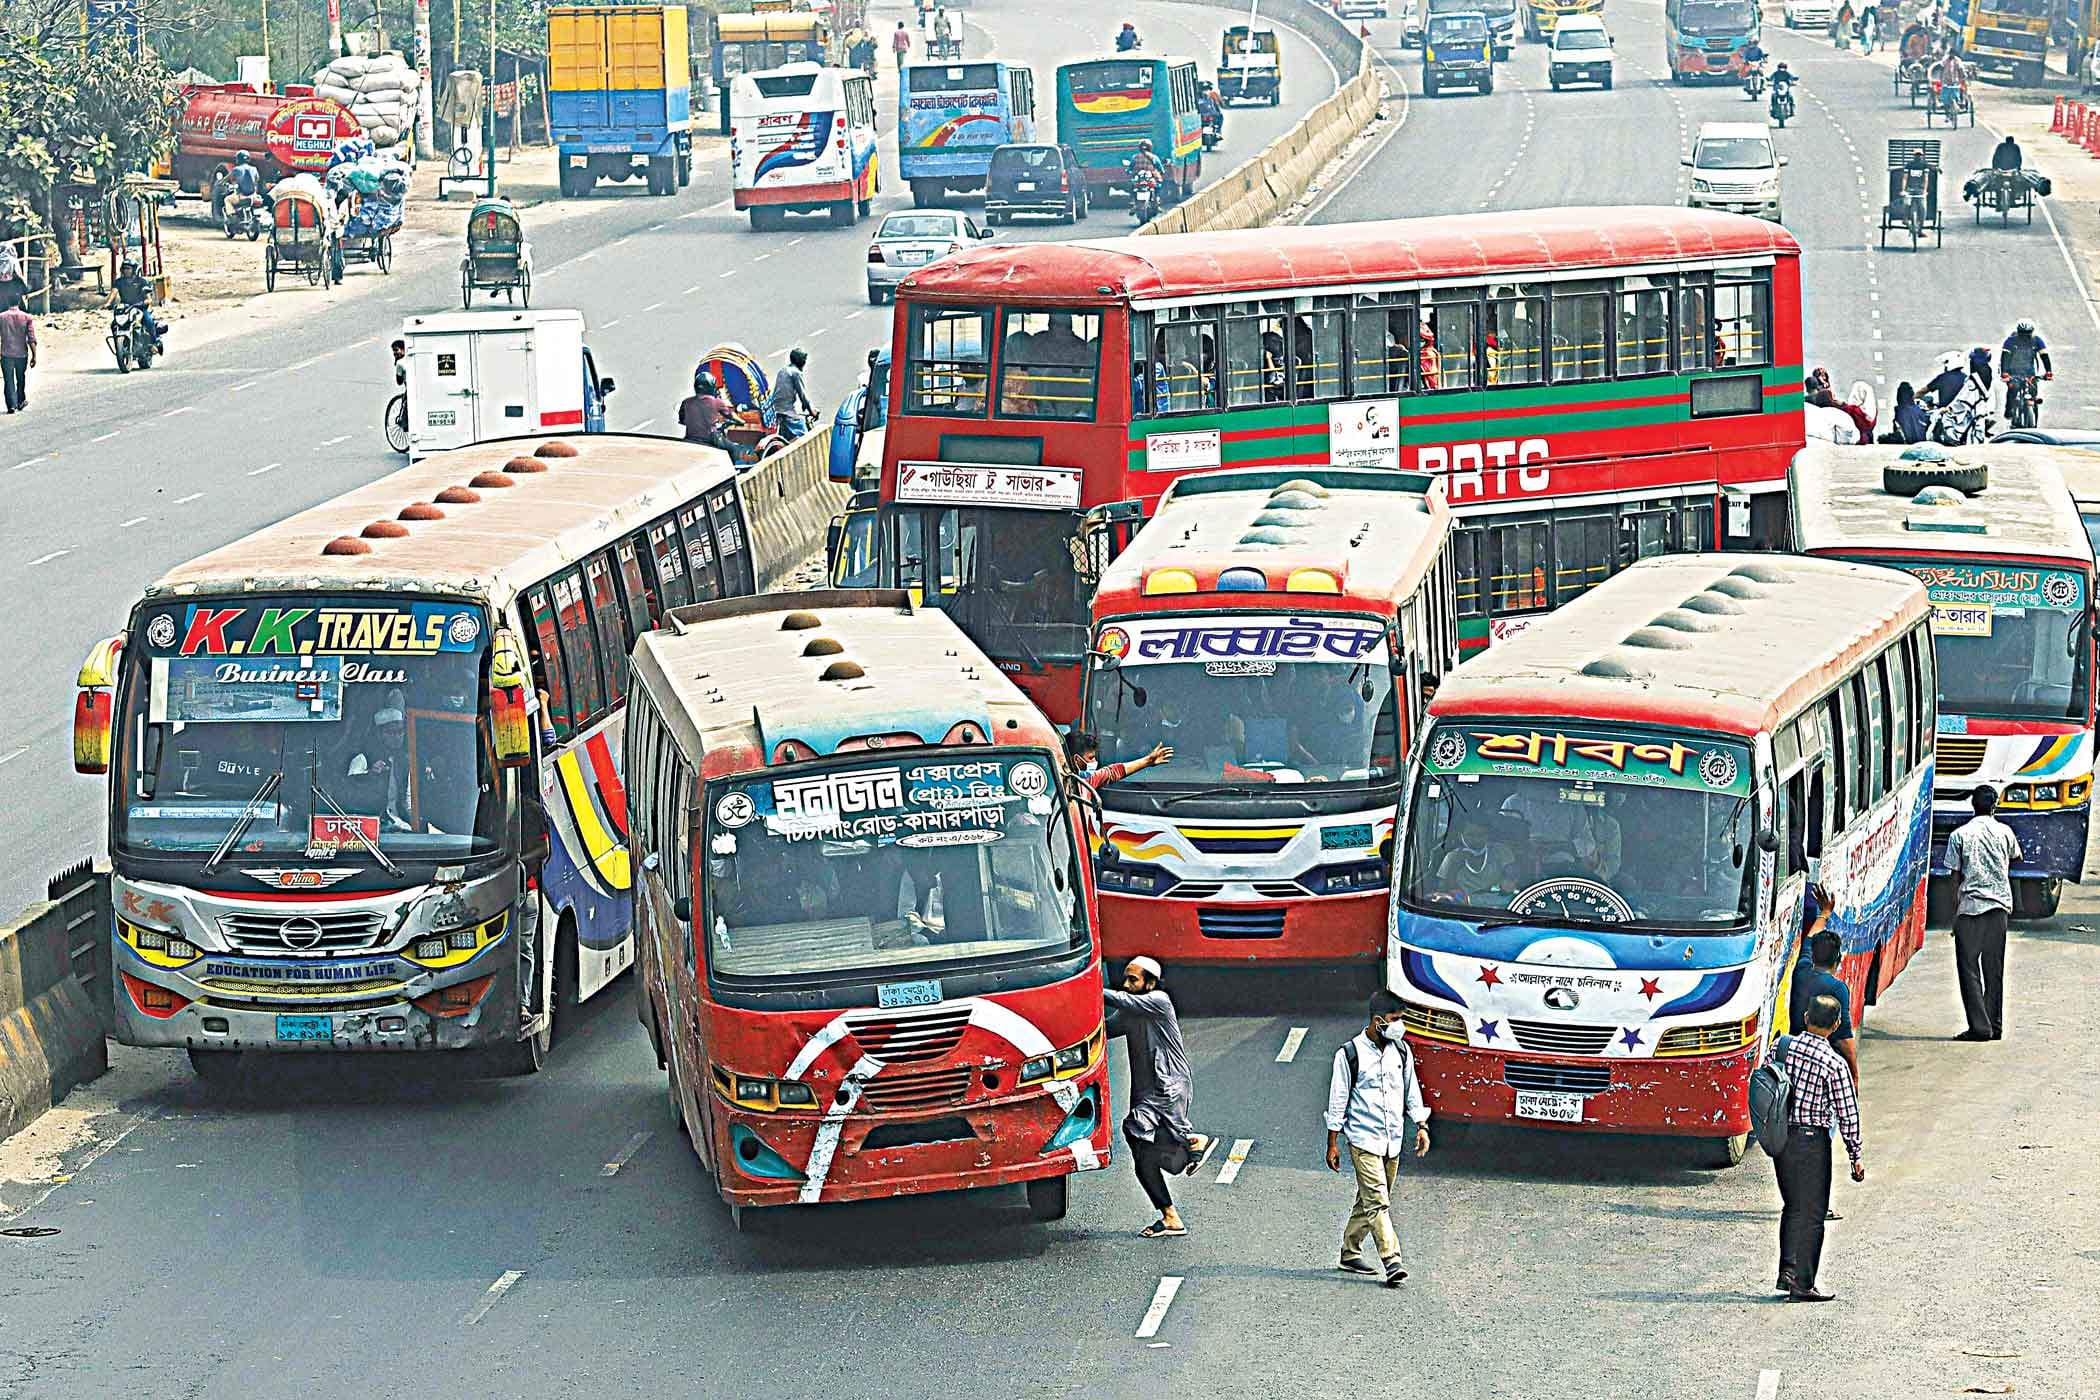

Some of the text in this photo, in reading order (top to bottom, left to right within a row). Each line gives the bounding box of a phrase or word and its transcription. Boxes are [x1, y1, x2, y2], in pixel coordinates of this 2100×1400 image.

[758, 114, 794, 126] শ্রাবণ
[296, 140, 332, 150] MEGHNA
[929, 468, 1044, 492] গাউছিয়া টু সাভার
[1417, 438, 1550, 500] BRTC
[317, 613, 446, 650] TRAVELS
[1139, 618, 1384, 659] লাব্বাইক
[215, 662, 408, 683] Business Class
[1468, 730, 1700, 776] শ্রাবণ
[218, 761, 261, 776] STYLE
[905, 761, 1003, 783] এক্সপ্রেস
[773, 767, 901, 821] মনজিল
[287, 872, 315, 885] Hino
[1525, 908, 1532, 916] 0
[1535, 900, 1546, 909] 20
[1551, 893, 1562, 902] 40
[1567, 892, 1580, 901] 60
[1585, 896, 1597, 905] 80
[1601, 914, 1617, 922] 120
[207, 963, 396, 980] EDUCATION FOR HUMAN LIFE
[1555, 976, 1574, 986] নামে
